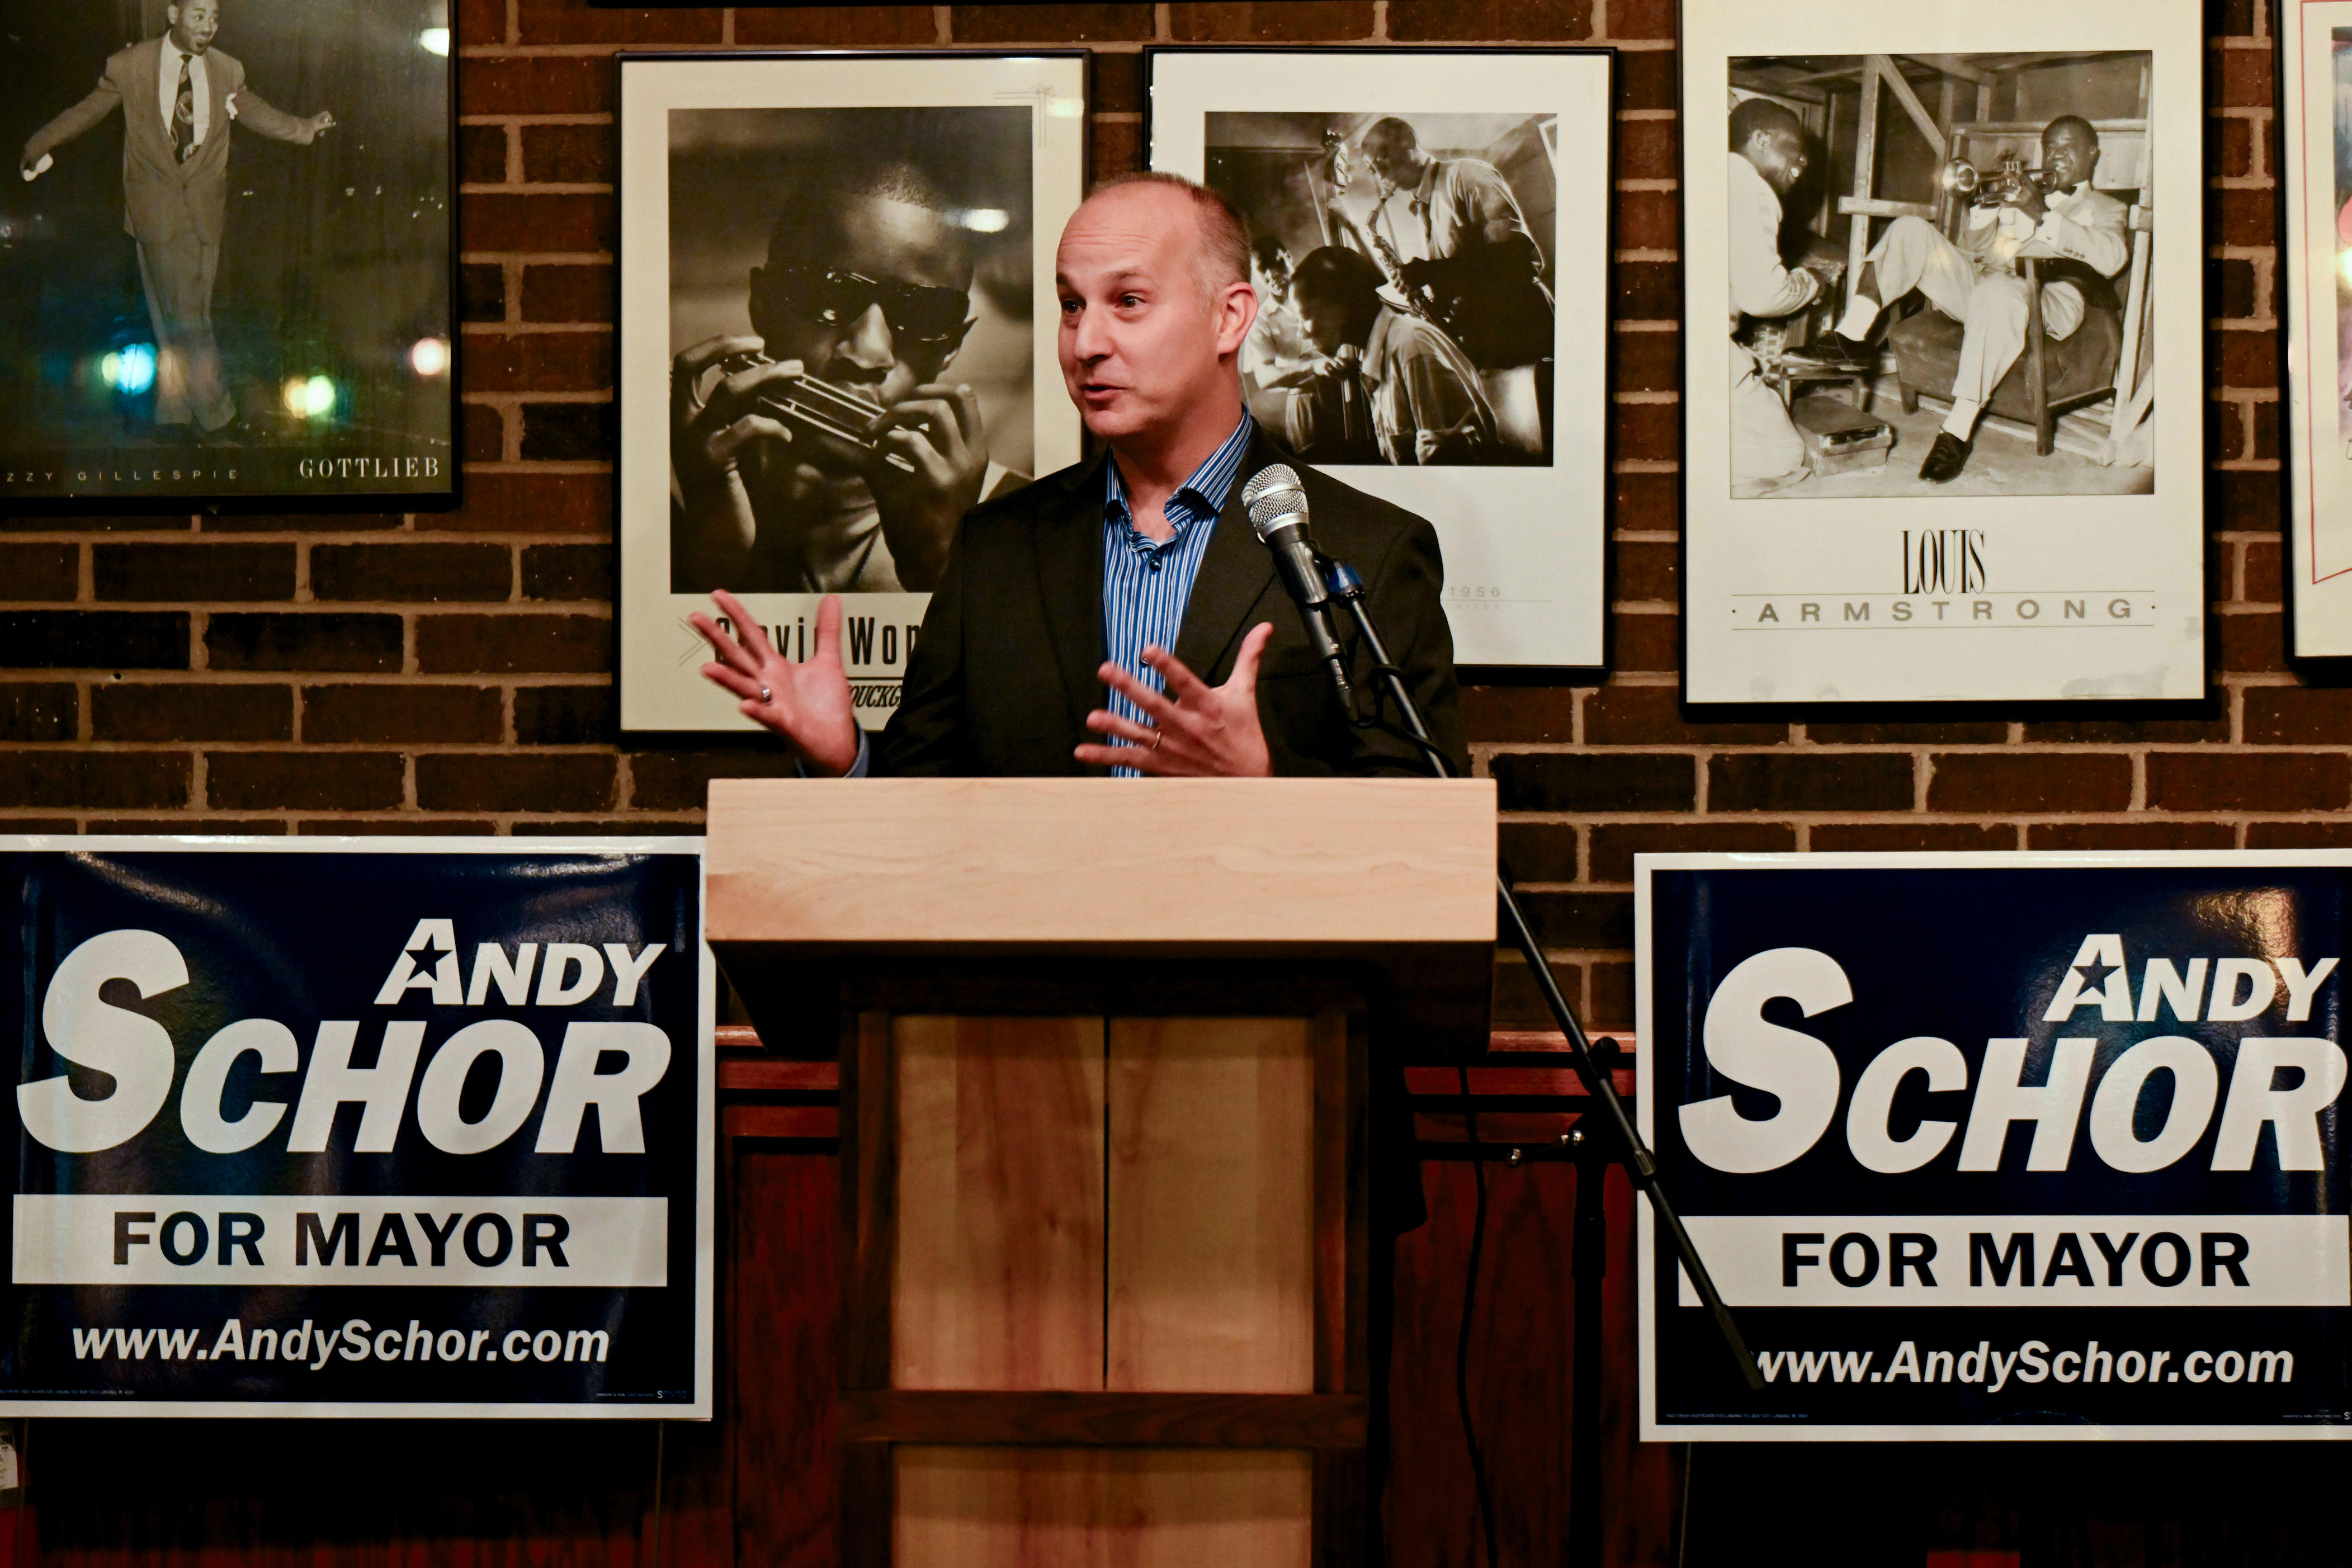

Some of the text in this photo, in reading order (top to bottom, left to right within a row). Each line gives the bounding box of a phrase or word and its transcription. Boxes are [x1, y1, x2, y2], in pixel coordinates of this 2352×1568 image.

[77, 470, 237, 481] GILLESPIE
[299, 457, 439, 478] GOTTLIEB
[1901, 529, 1986, 594] LOUIS
[1449, 585, 1500, 598] 1956
[1757, 599, 2131, 623] ARMSTRONG
[374, 918, 667, 1006] ANDY
[2042, 934, 2340, 1022] ANDY
[17, 929, 672, 1154] SCHOR
[1678, 947, 2348, 1174] SCHOR
[114, 1211, 570, 1268] FOR MAYOR
[1782, 1231, 2251, 1288] FOR MAYOR
[73, 1319, 610, 1371] www.AndySchor.com
[1756, 1340, 2294, 1393] www.AndySchor.com
